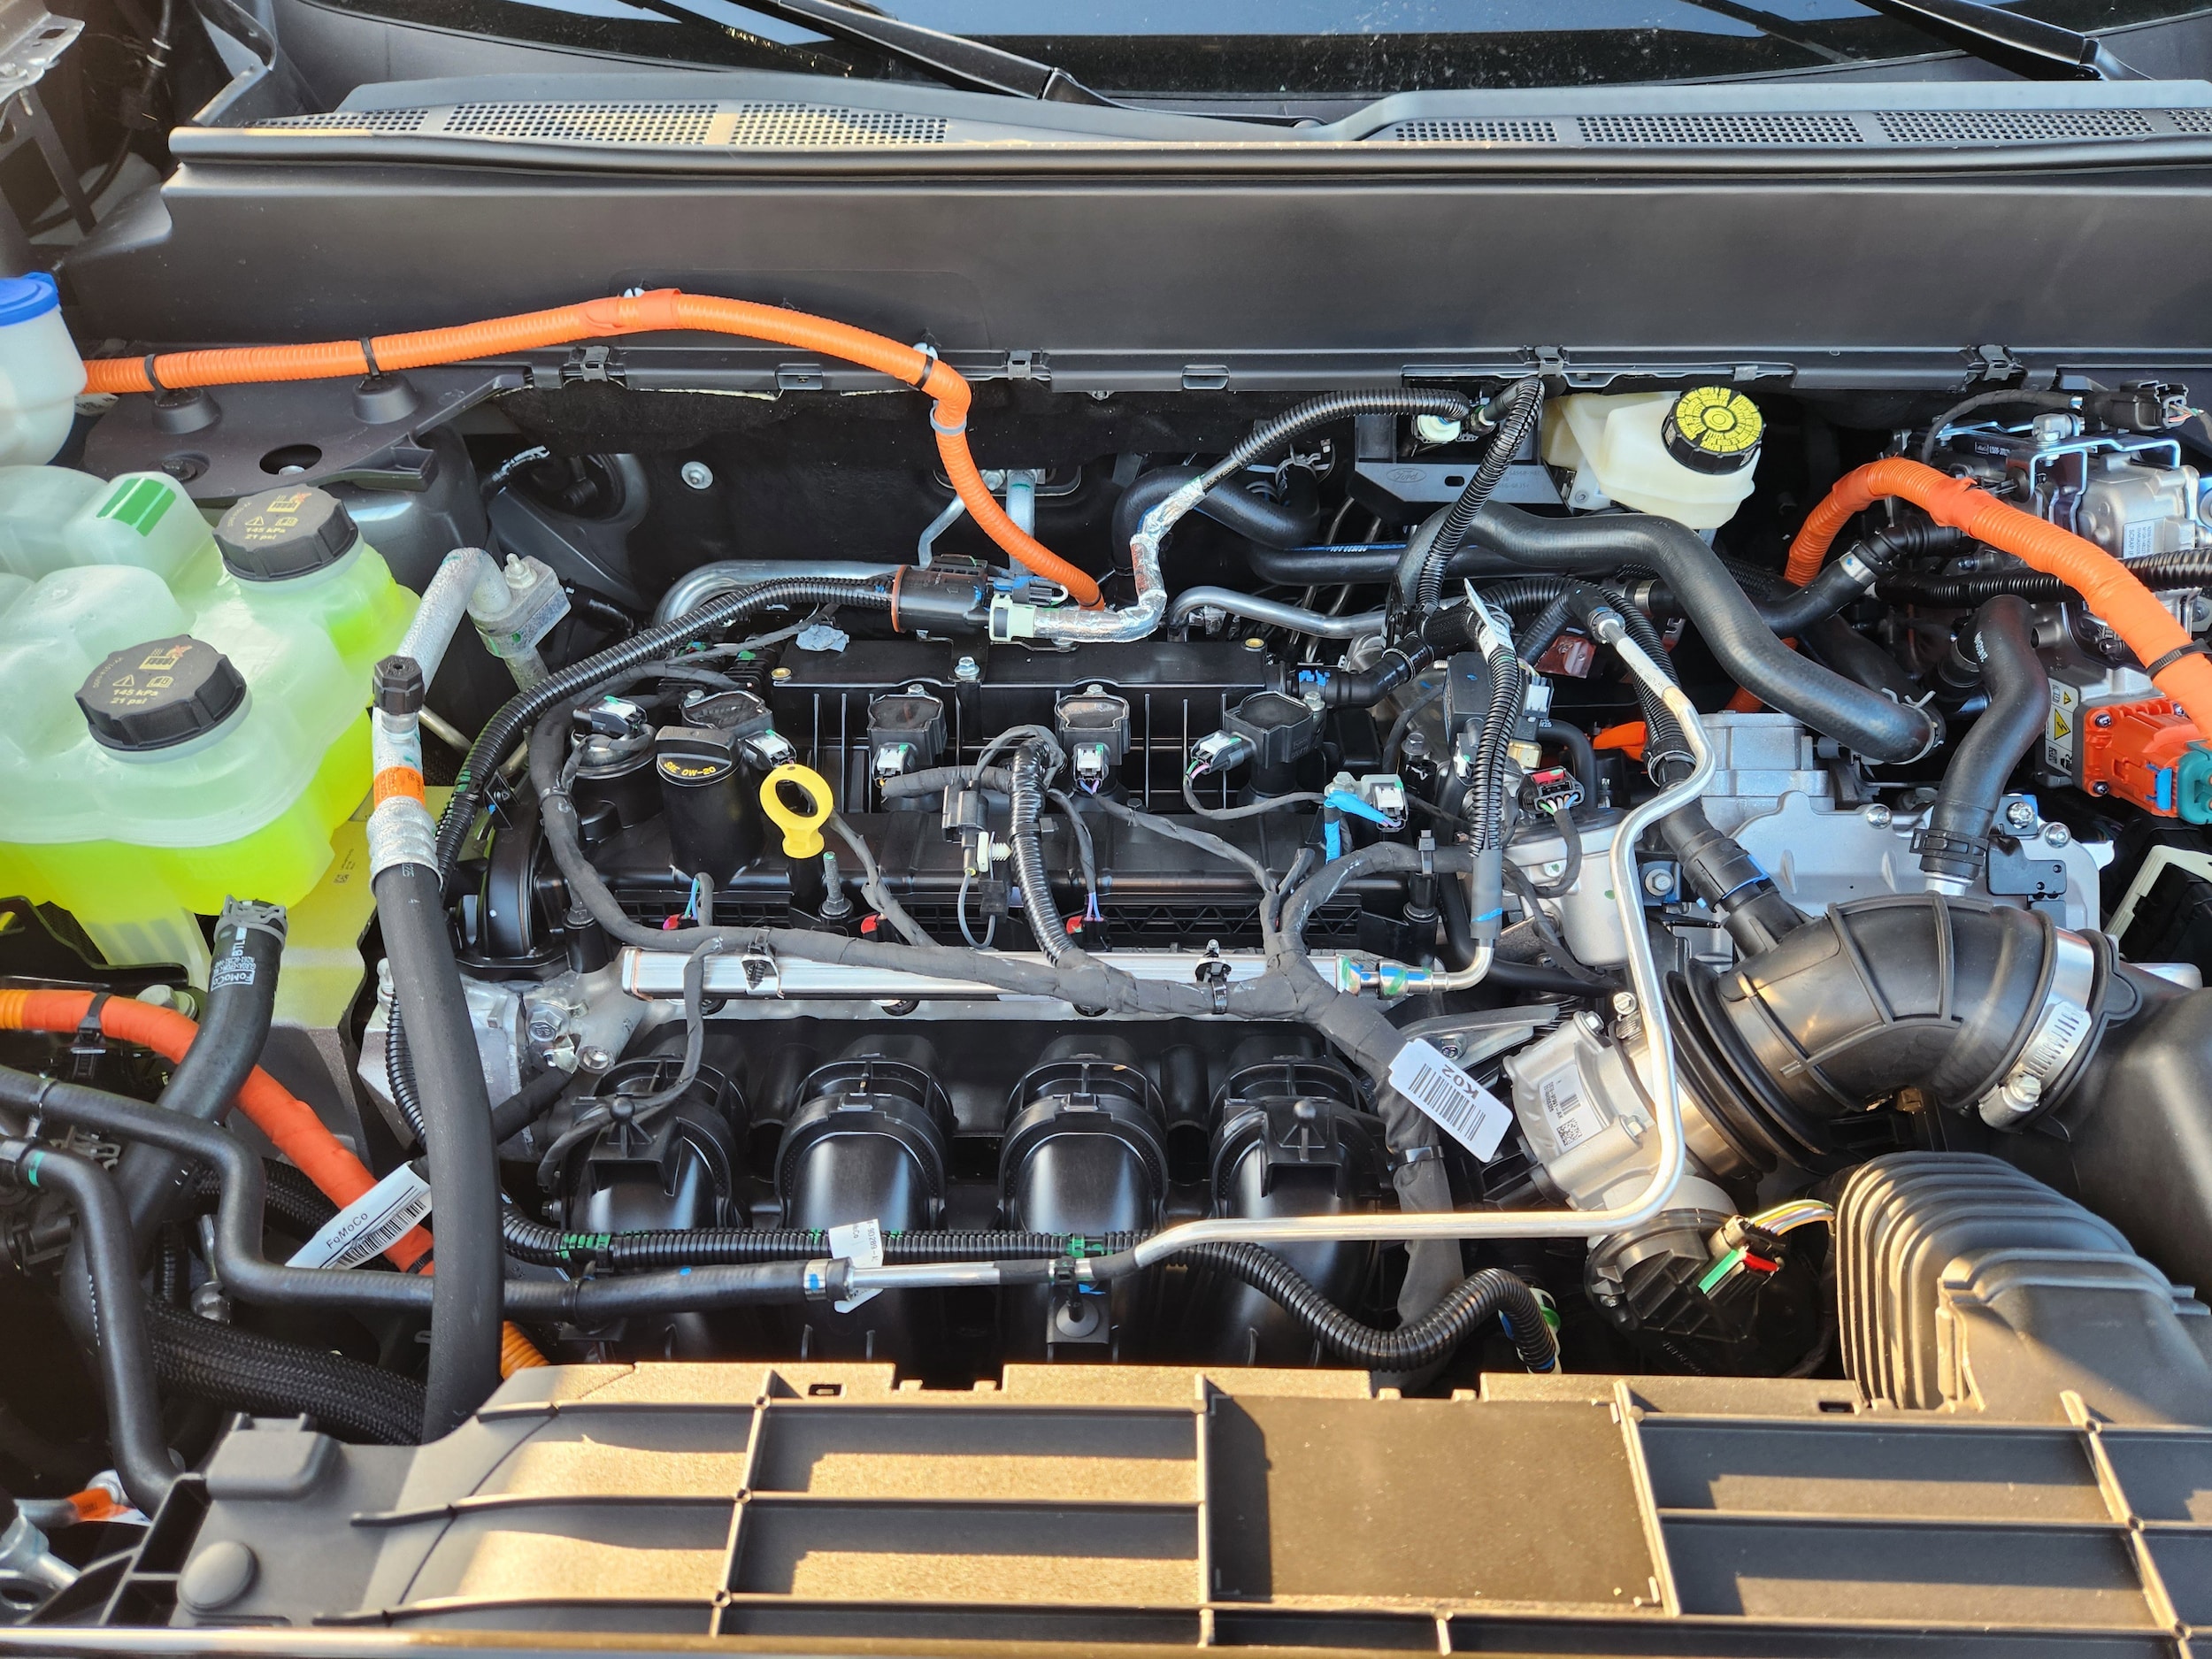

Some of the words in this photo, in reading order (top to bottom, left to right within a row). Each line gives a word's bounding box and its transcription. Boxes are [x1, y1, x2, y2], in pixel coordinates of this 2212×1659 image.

[664, 762, 680, 773] SAE
[682, 766, 716, 776] 0W-20
[232, 940, 245, 956] BTL
[213, 972, 252, 985] FoMoCo
[1441, 1064, 1479, 1100] K02
[326, 1212, 368, 1249] FoMoCo
